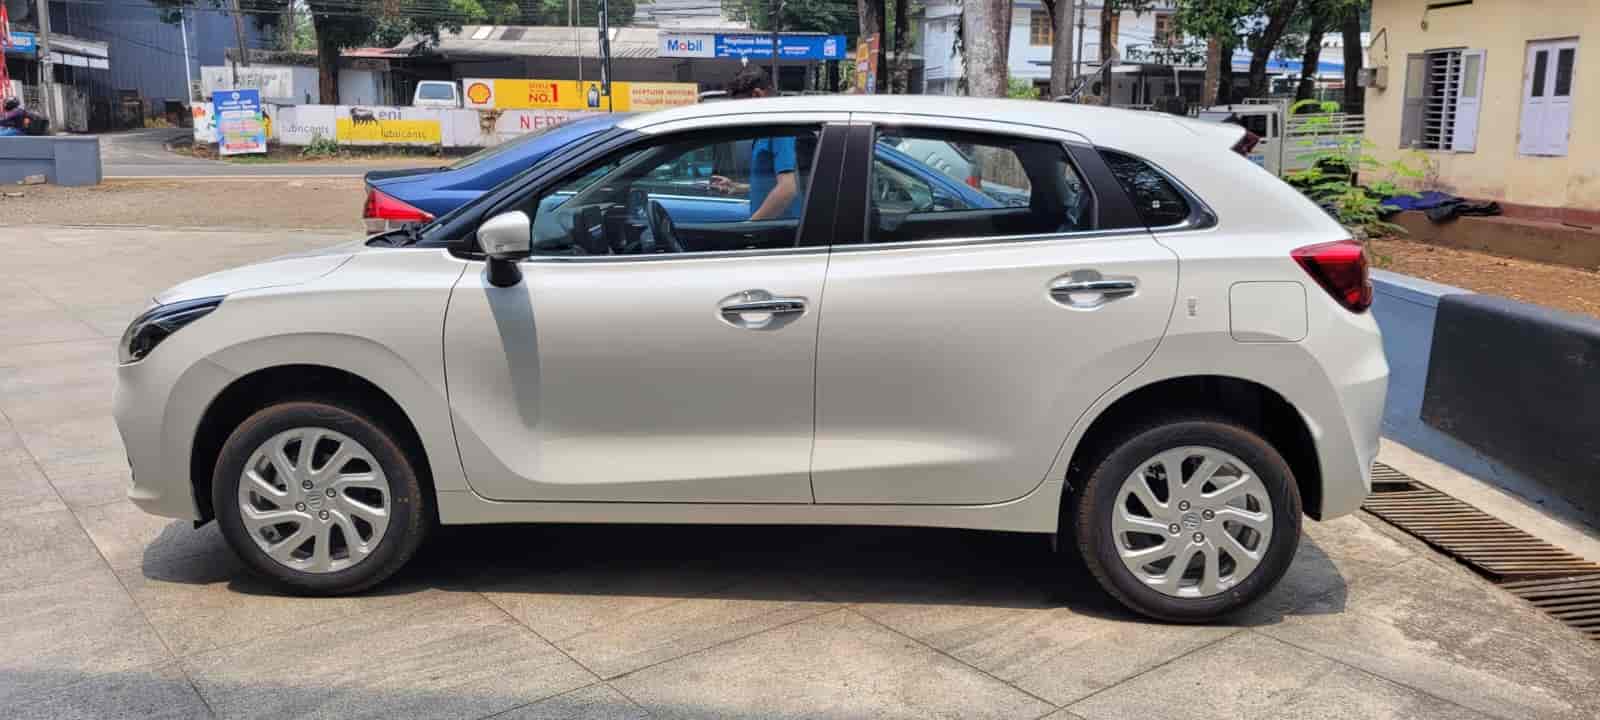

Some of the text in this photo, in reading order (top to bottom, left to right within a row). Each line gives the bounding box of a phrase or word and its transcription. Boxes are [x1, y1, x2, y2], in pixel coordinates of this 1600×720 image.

[667, 39, 703, 52] Mobil
[378, 109, 402, 121] eni
[520, 115, 569, 129] NEPT
[286, 123, 329, 134] ubricants
